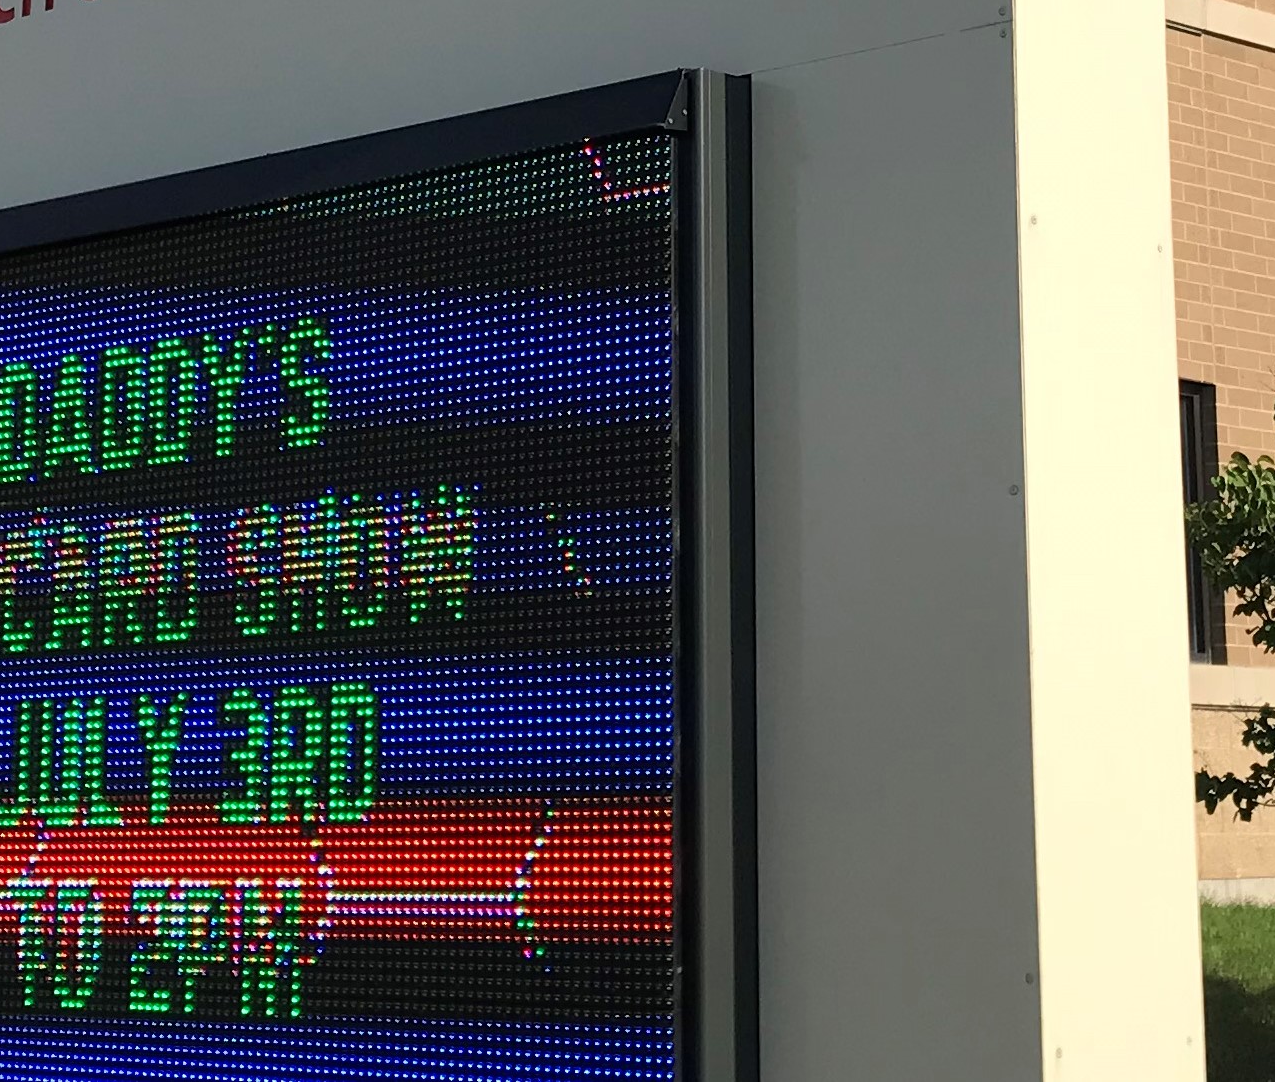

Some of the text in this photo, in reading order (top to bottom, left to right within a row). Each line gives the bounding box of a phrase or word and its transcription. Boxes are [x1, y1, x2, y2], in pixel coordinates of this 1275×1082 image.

[228, 486, 479, 637] SHOW
[220, 682, 380, 825] 3RD
[9, 878, 104, 1010] TO
[129, 878, 306, 1017] 2PM
